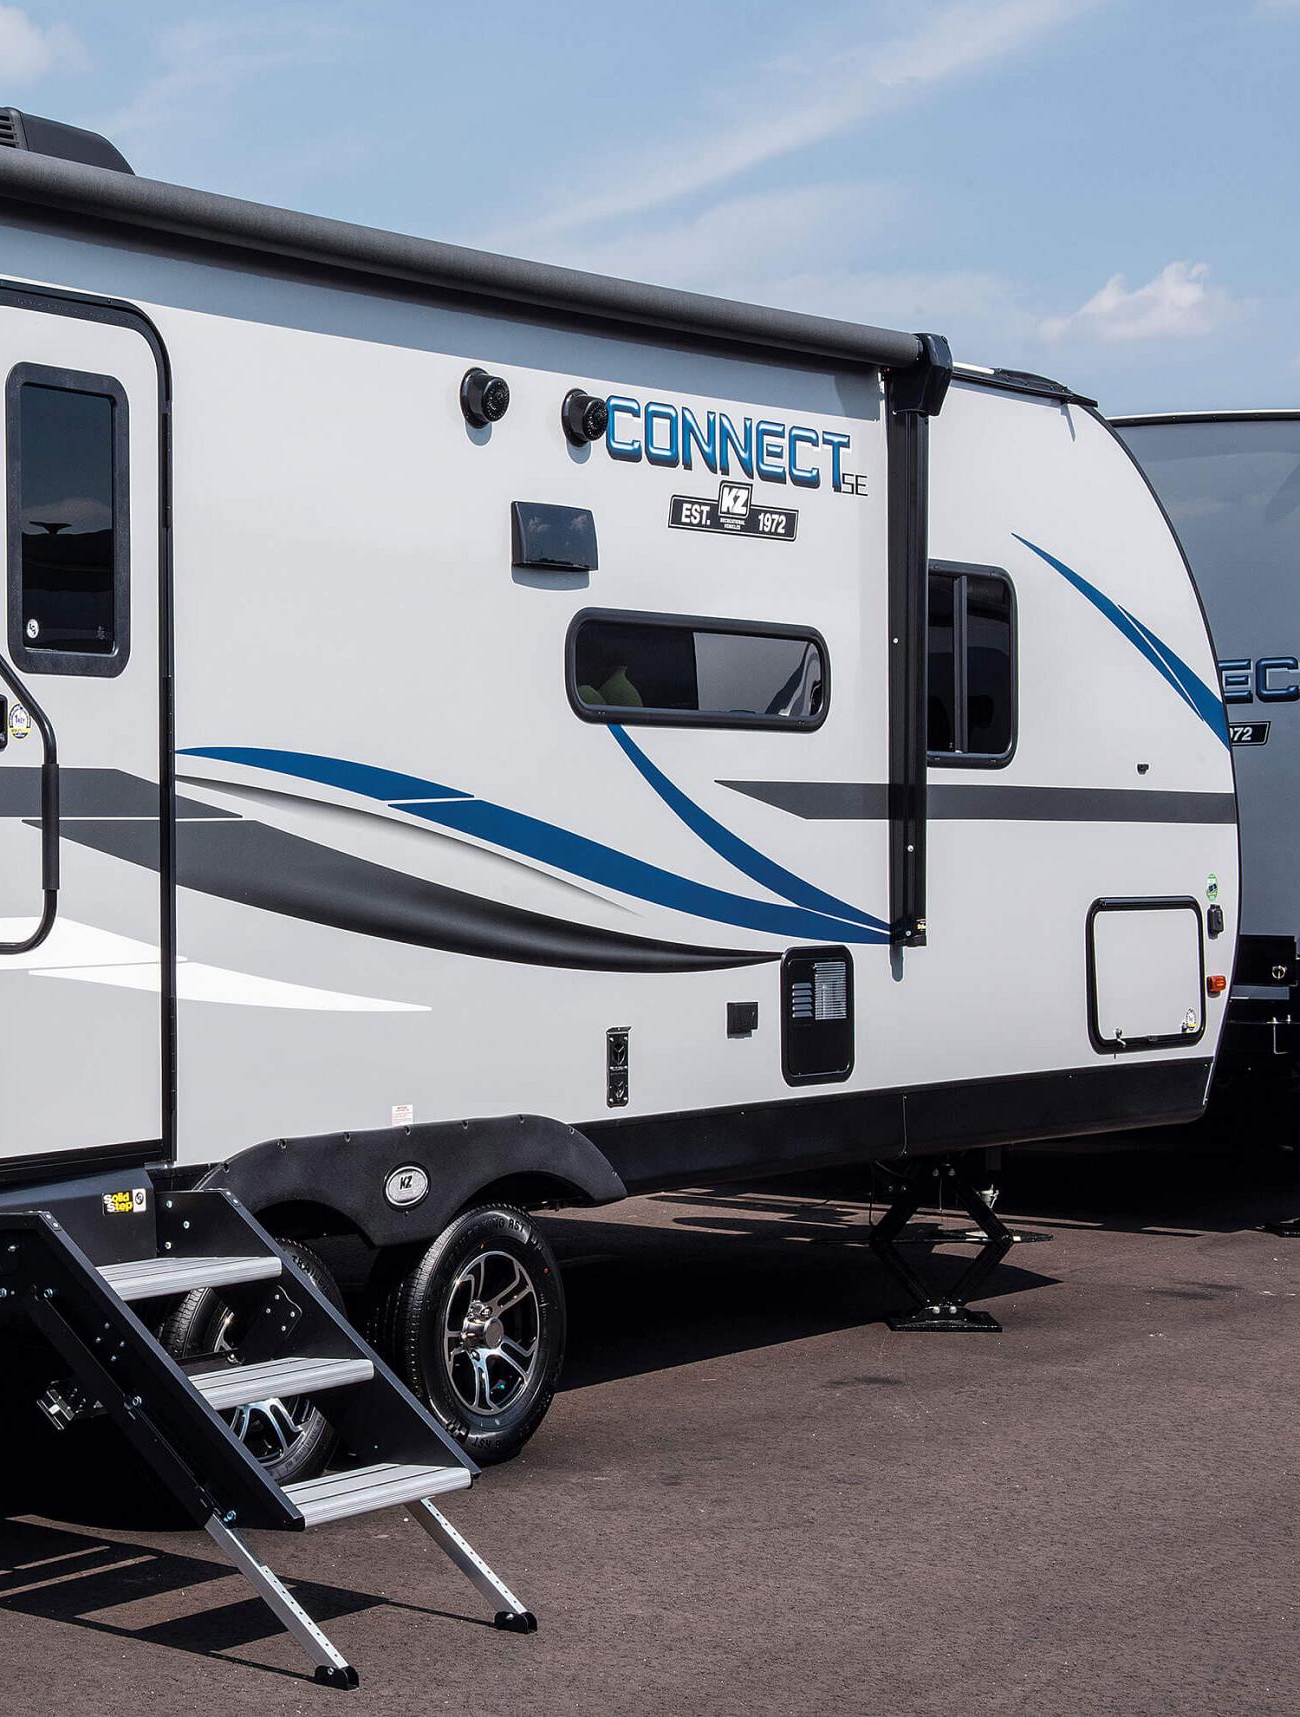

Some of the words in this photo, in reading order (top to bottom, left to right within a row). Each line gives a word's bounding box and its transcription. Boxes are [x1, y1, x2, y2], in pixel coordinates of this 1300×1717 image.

[605, 395, 851, 493] CONNECT
[841, 472, 868, 497] SE
[720, 486, 748, 515] KZ
[680, 503, 711, 526] EST.
[757, 512, 786, 534] 1972
[399, 1175, 413, 1190] KZ
[103, 1191, 130, 1204] Solid
[106, 1201, 133, 1213] Step
